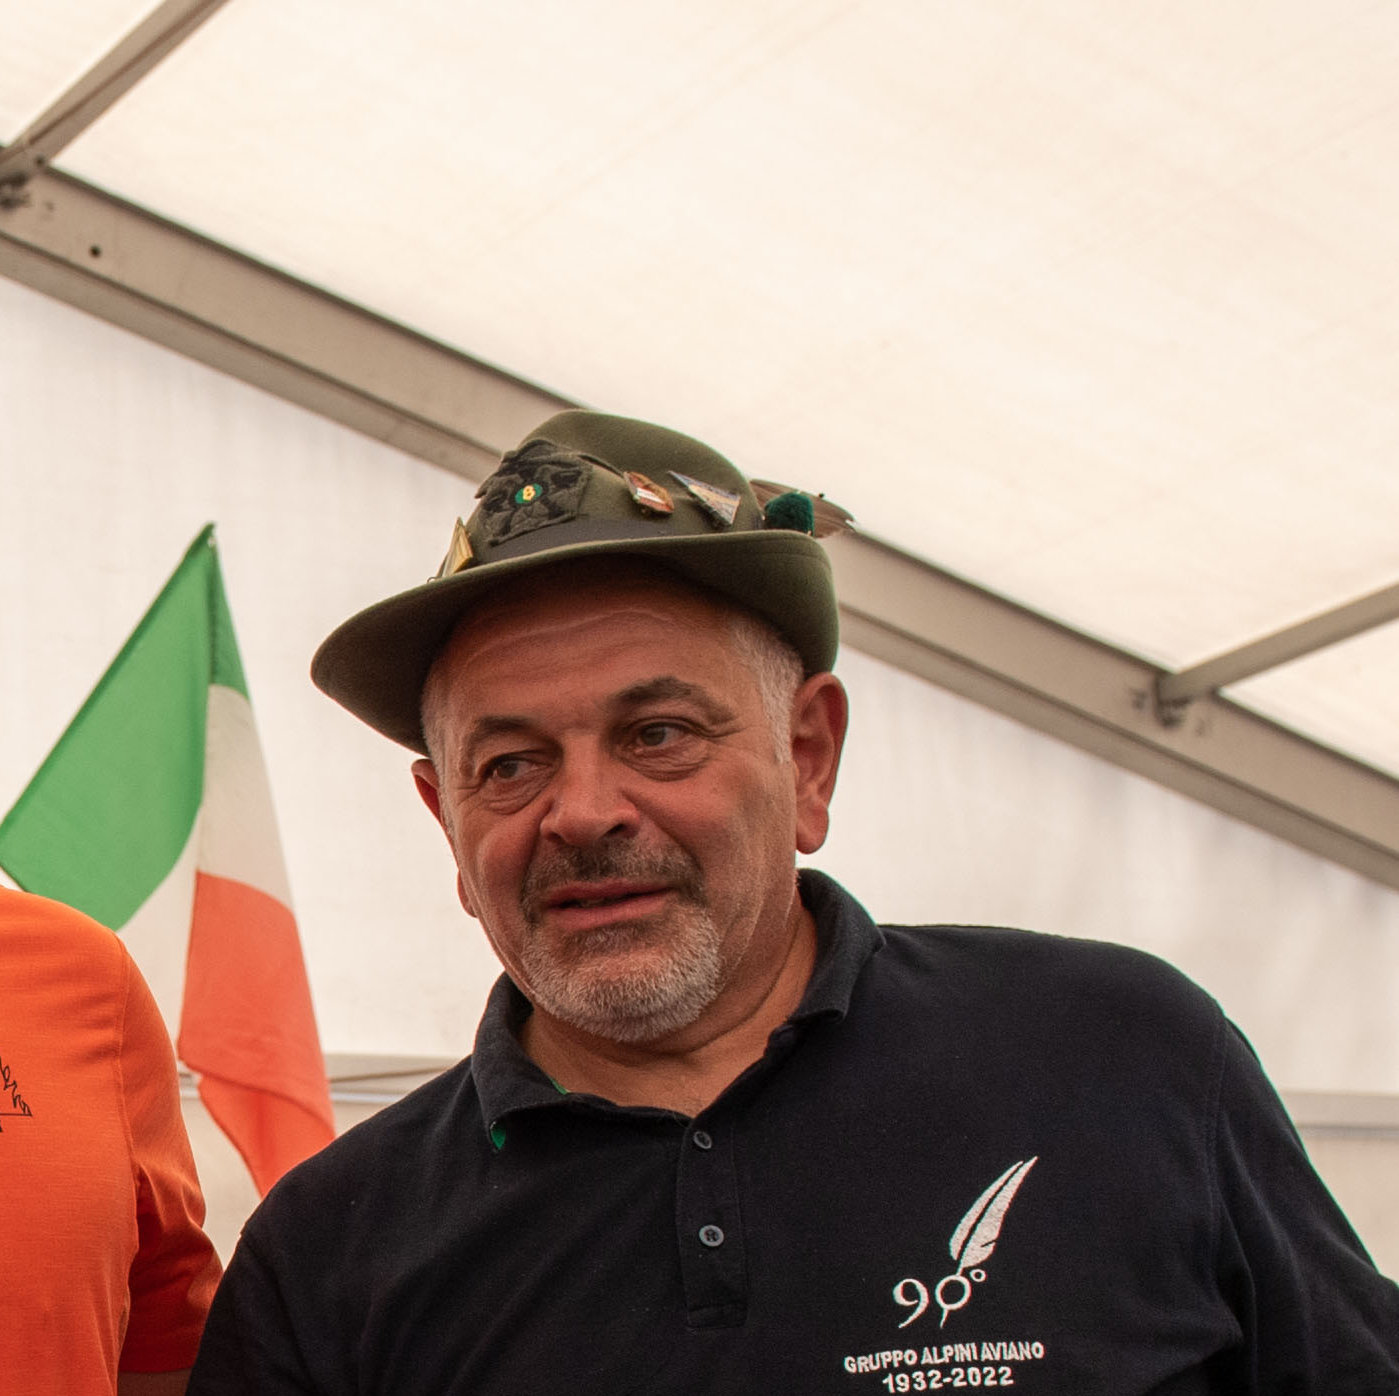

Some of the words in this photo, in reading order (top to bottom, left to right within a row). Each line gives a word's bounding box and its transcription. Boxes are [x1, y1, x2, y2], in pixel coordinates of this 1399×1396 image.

[843, 1349, 917, 1374] GRUPPO
[921, 1342, 978, 1366] ALPINI
[981, 1341, 1045, 1361] AVIANO
[882, 1366, 1014, 1394] 1932-2022
